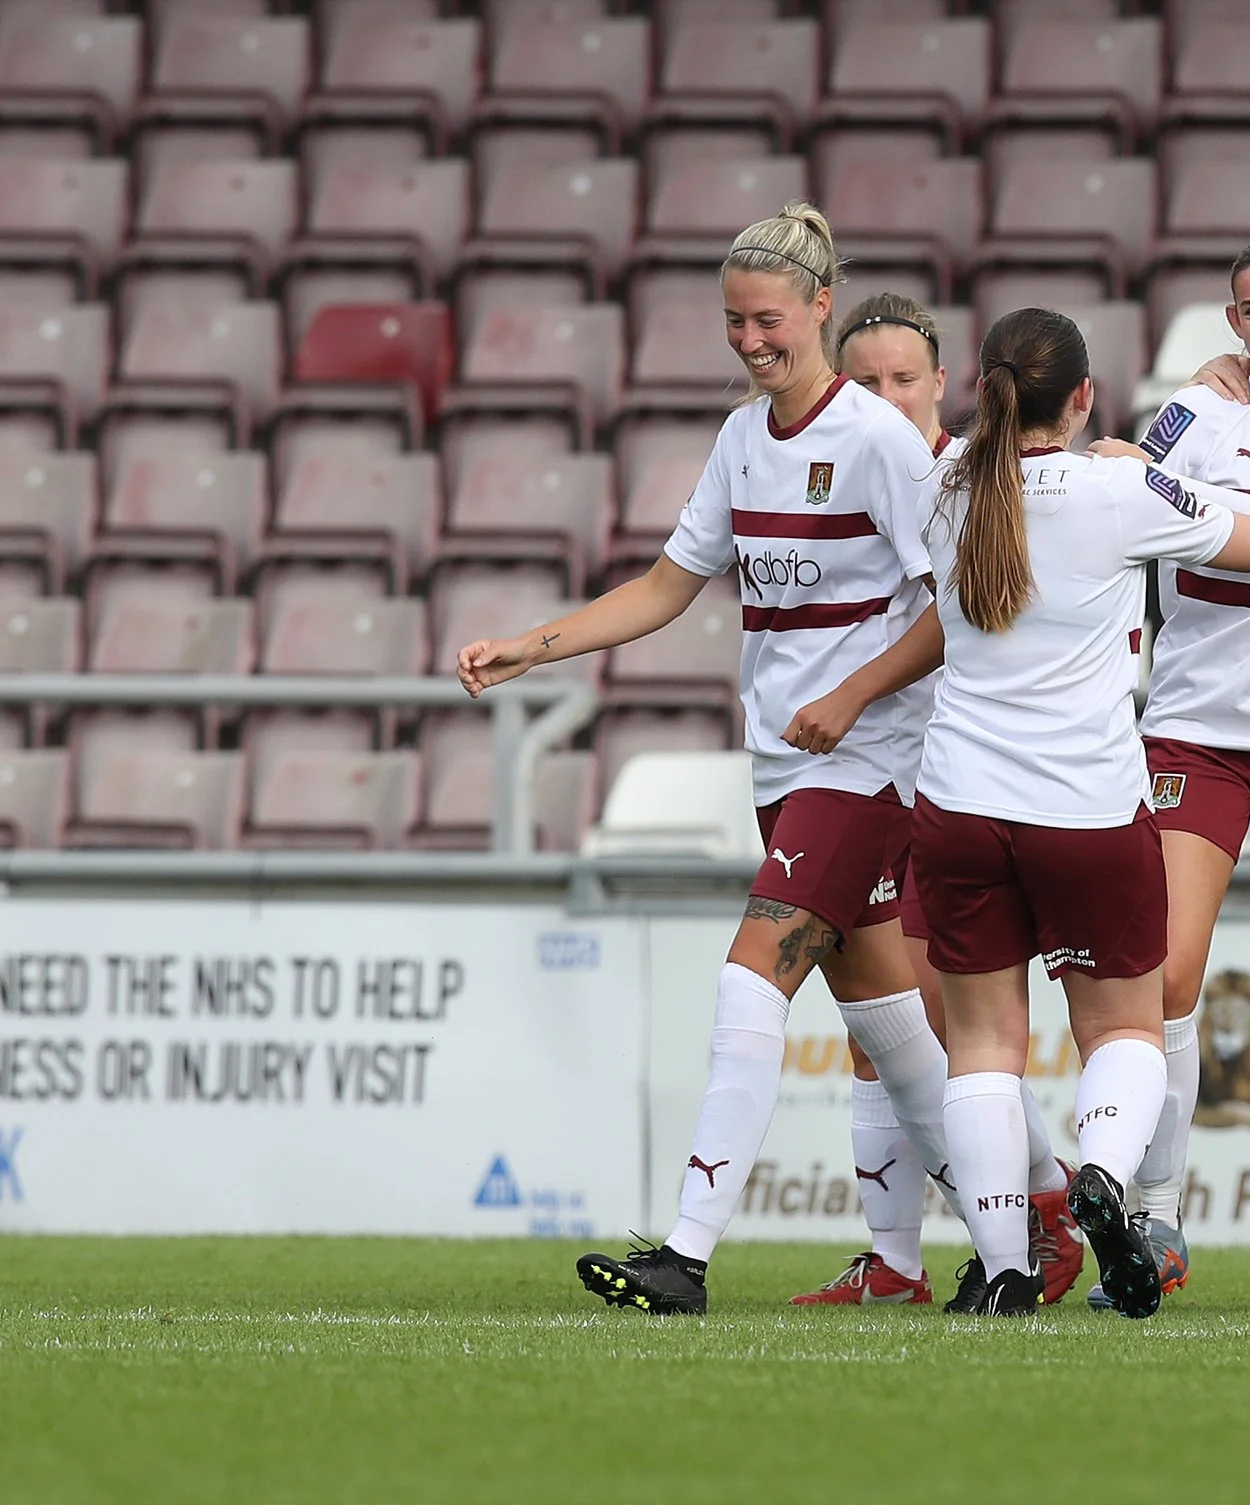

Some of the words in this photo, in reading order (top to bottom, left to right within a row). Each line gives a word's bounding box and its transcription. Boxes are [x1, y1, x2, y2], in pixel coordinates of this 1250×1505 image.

[1032, 487, 1067, 496] SERVICES
[1077, 948, 1090, 957] of
[104, 955, 176, 1019] THE
[192, 955, 276, 1019] NHS
[291, 957, 341, 1019] TO
[355, 957, 465, 1022] HELP
[98, 1039, 152, 1101] OR
[165, 1041, 314, 1104] INJURY
[326, 1043, 436, 1105] VISIT
[1077, 1105, 1118, 1135] NTFC
[977, 1194, 1025, 1213] NTFC
